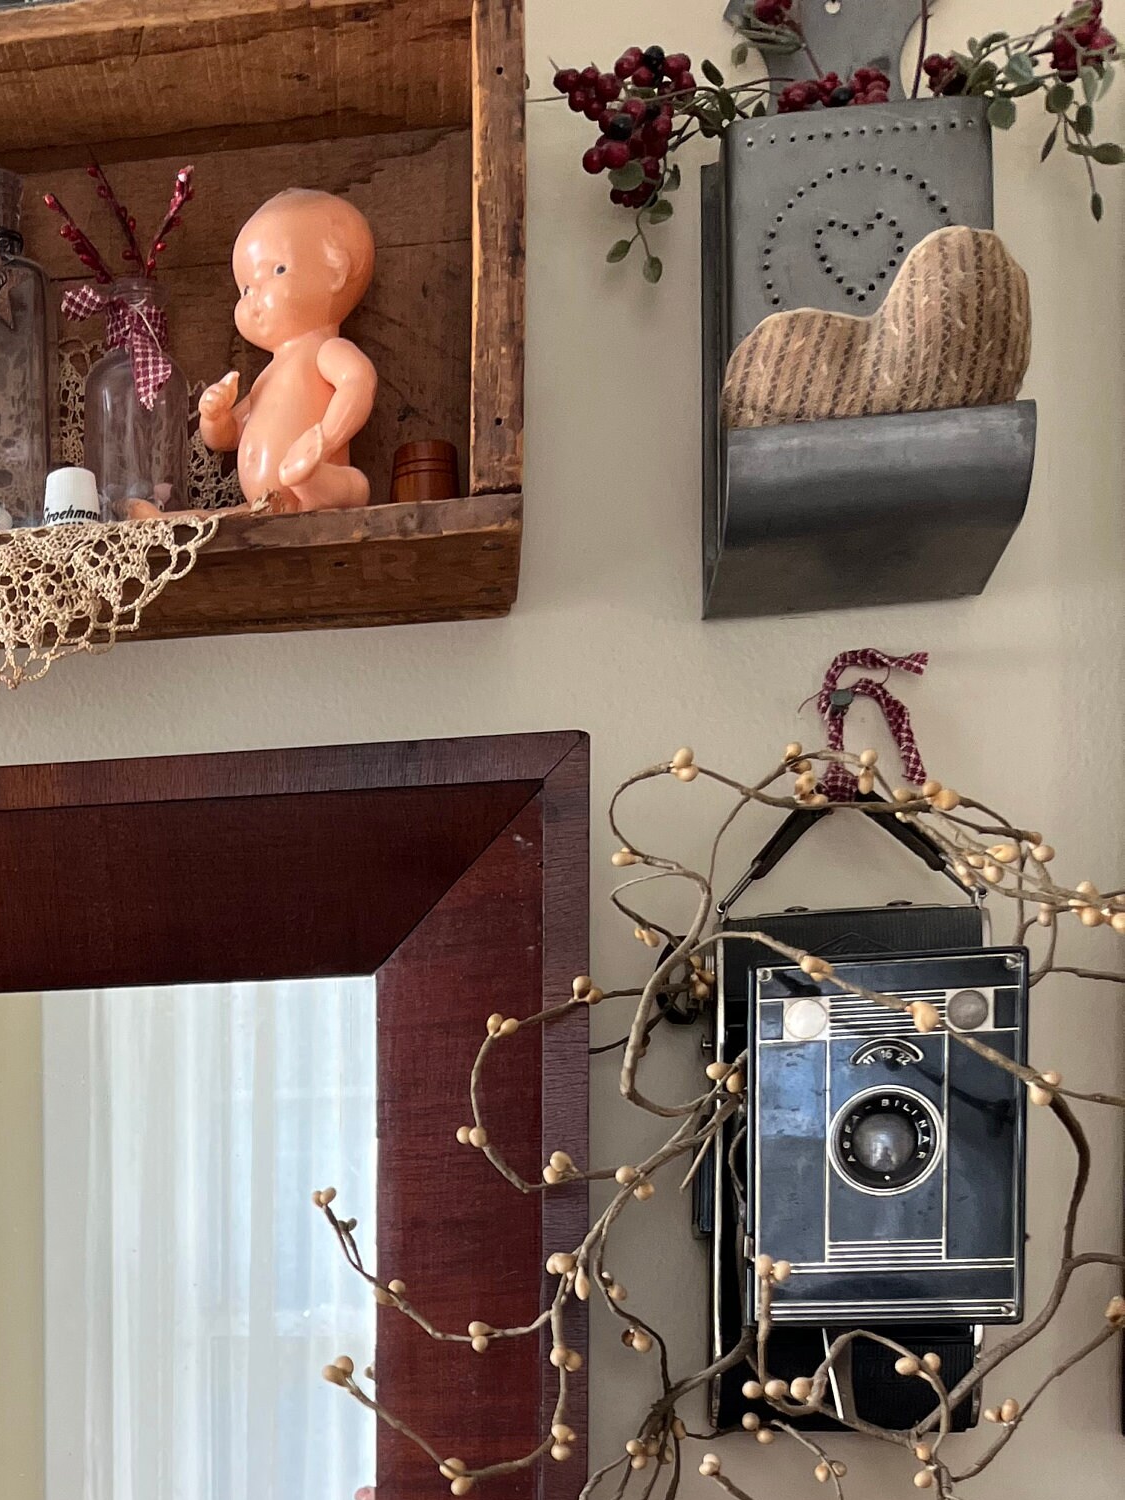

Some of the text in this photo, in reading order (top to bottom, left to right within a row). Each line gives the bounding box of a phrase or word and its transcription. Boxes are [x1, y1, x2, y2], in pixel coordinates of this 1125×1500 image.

[862, 1049, 911, 1066] 11 16 22
